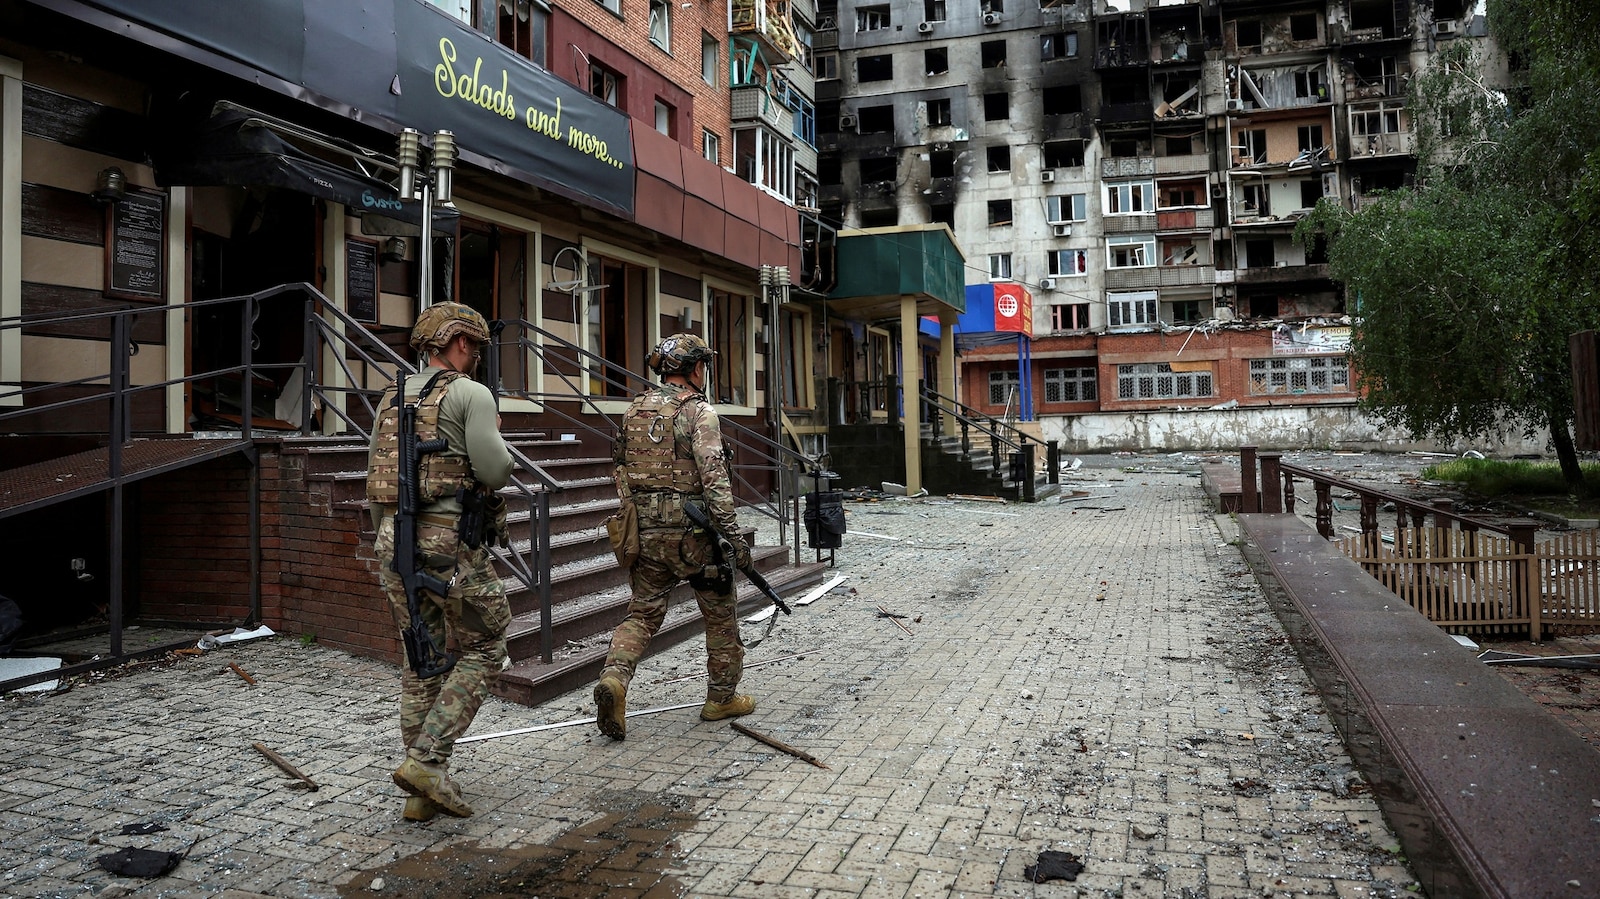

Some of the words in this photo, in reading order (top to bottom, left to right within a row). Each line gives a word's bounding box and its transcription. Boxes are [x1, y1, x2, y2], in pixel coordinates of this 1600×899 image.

[434, 37, 516, 121] Salads
[525, 96, 563, 141] and
[567, 125, 624, 170] more...
[313, 177, 334, 189] PIZZA
[361, 189, 403, 211] Gusto
